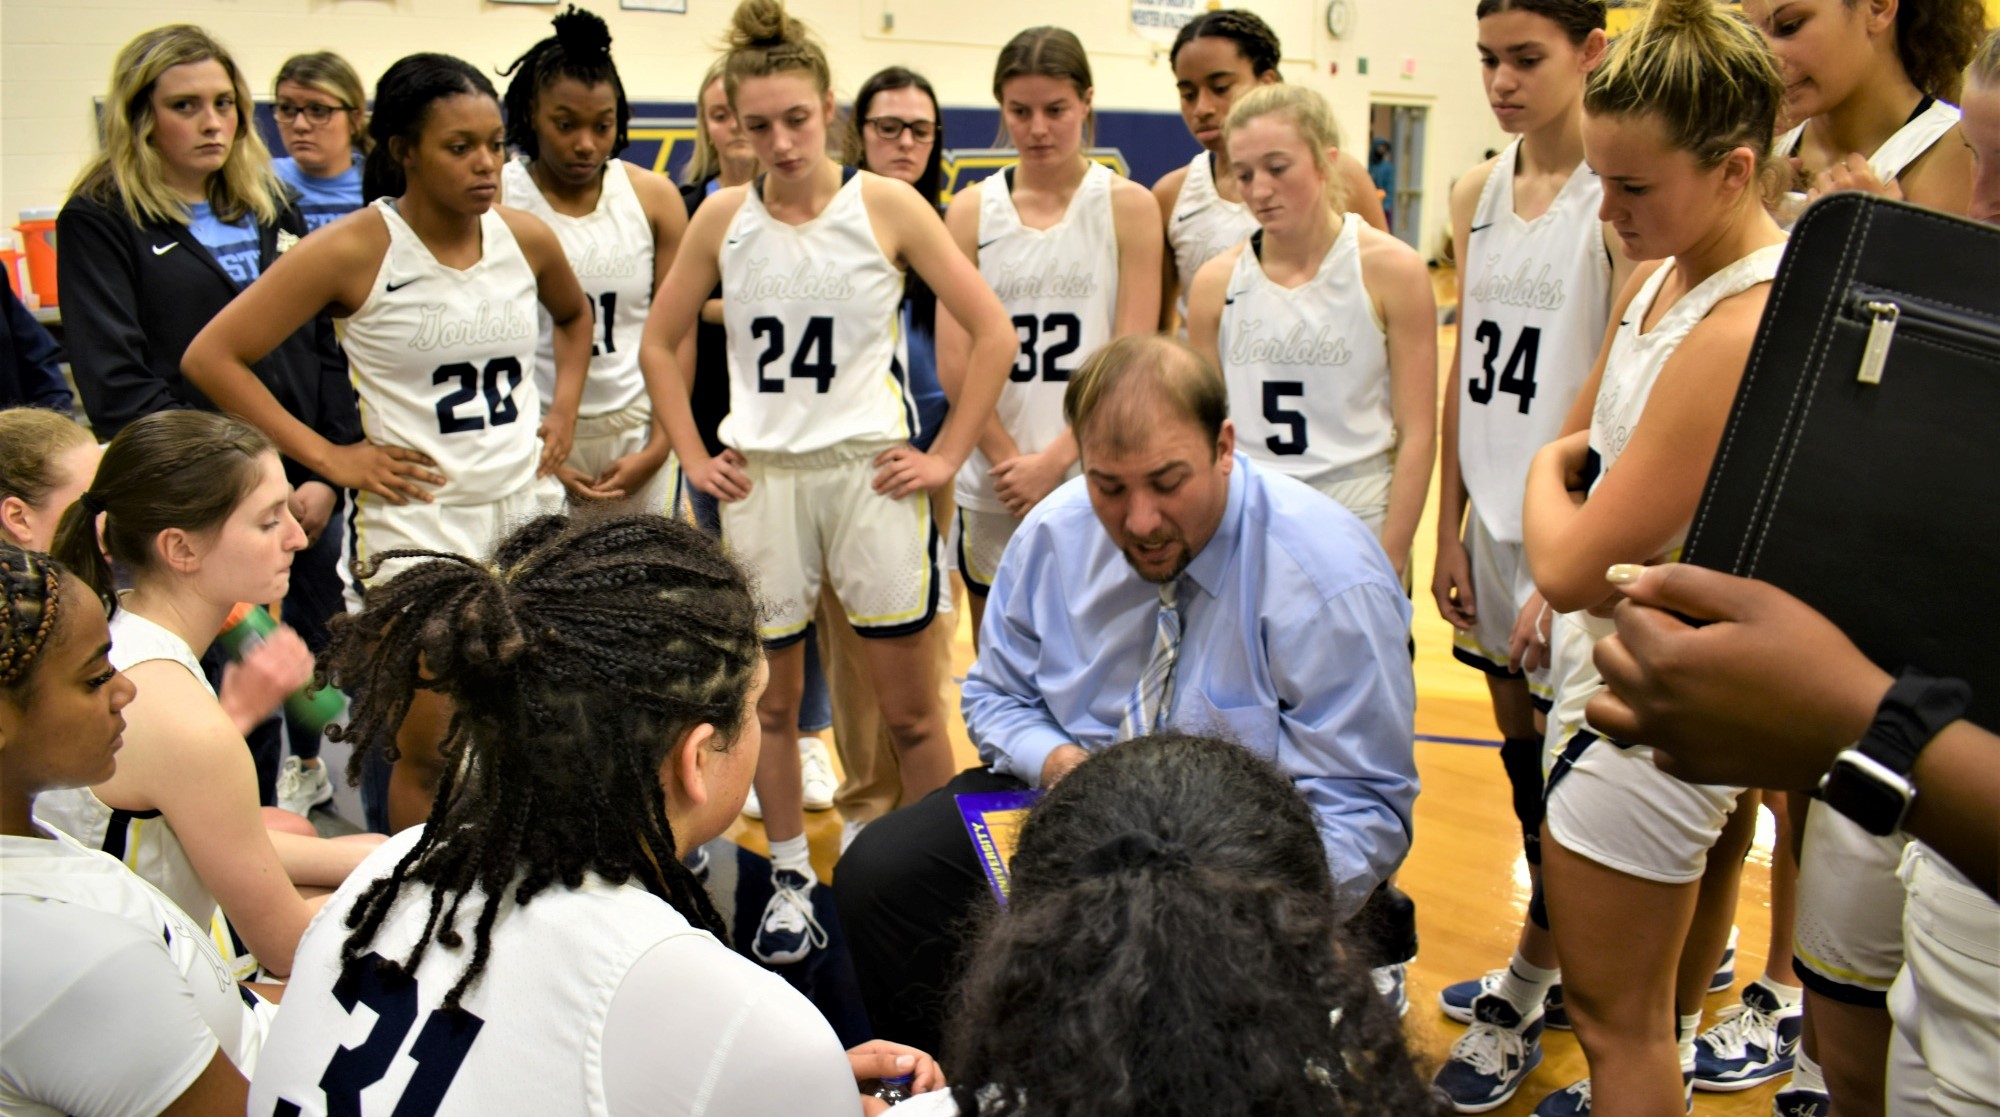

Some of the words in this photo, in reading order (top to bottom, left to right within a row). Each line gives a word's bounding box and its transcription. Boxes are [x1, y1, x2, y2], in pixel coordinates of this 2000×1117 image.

[751, 315, 837, 394] 24
[1009, 311, 1081, 382] 32
[1468, 318, 1541, 415] 34
[432, 355, 522, 434] 20
[1262, 380, 1309, 456] 5
[272, 951, 485, 1117] 31
